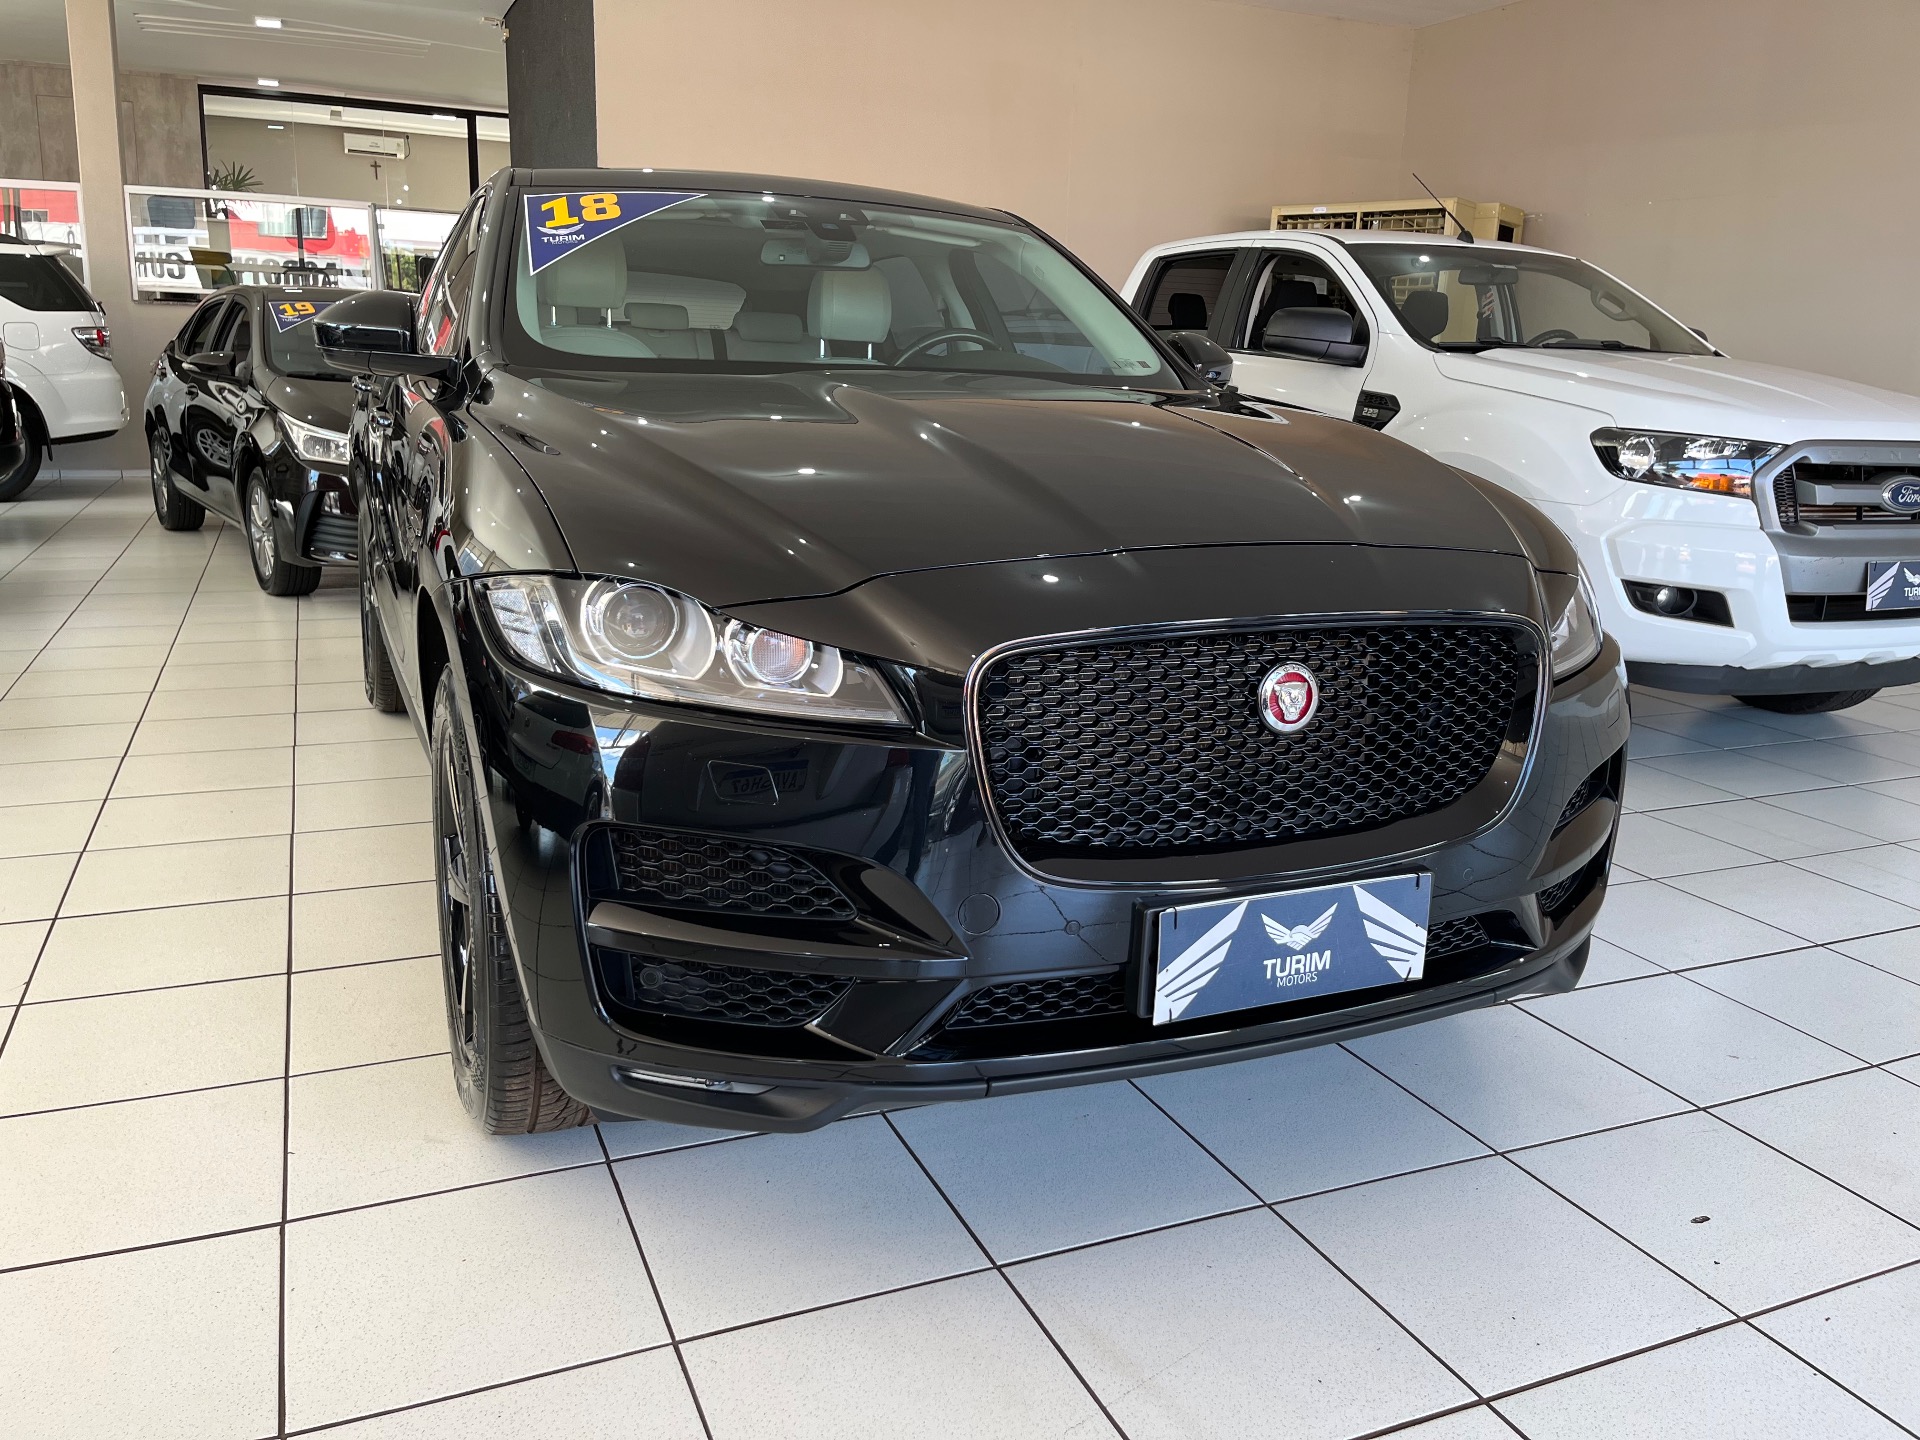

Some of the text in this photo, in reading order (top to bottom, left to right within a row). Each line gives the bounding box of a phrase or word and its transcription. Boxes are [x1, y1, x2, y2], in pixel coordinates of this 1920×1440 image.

[540, 193, 622, 229] 18
[541, 234, 586, 243] TURIM
[279, 301, 317, 316] 19
[1828, 449, 1920, 462] RAN
[1263, 949, 1332, 980] TURIM
[1276, 971, 1318, 988] MOTORS
